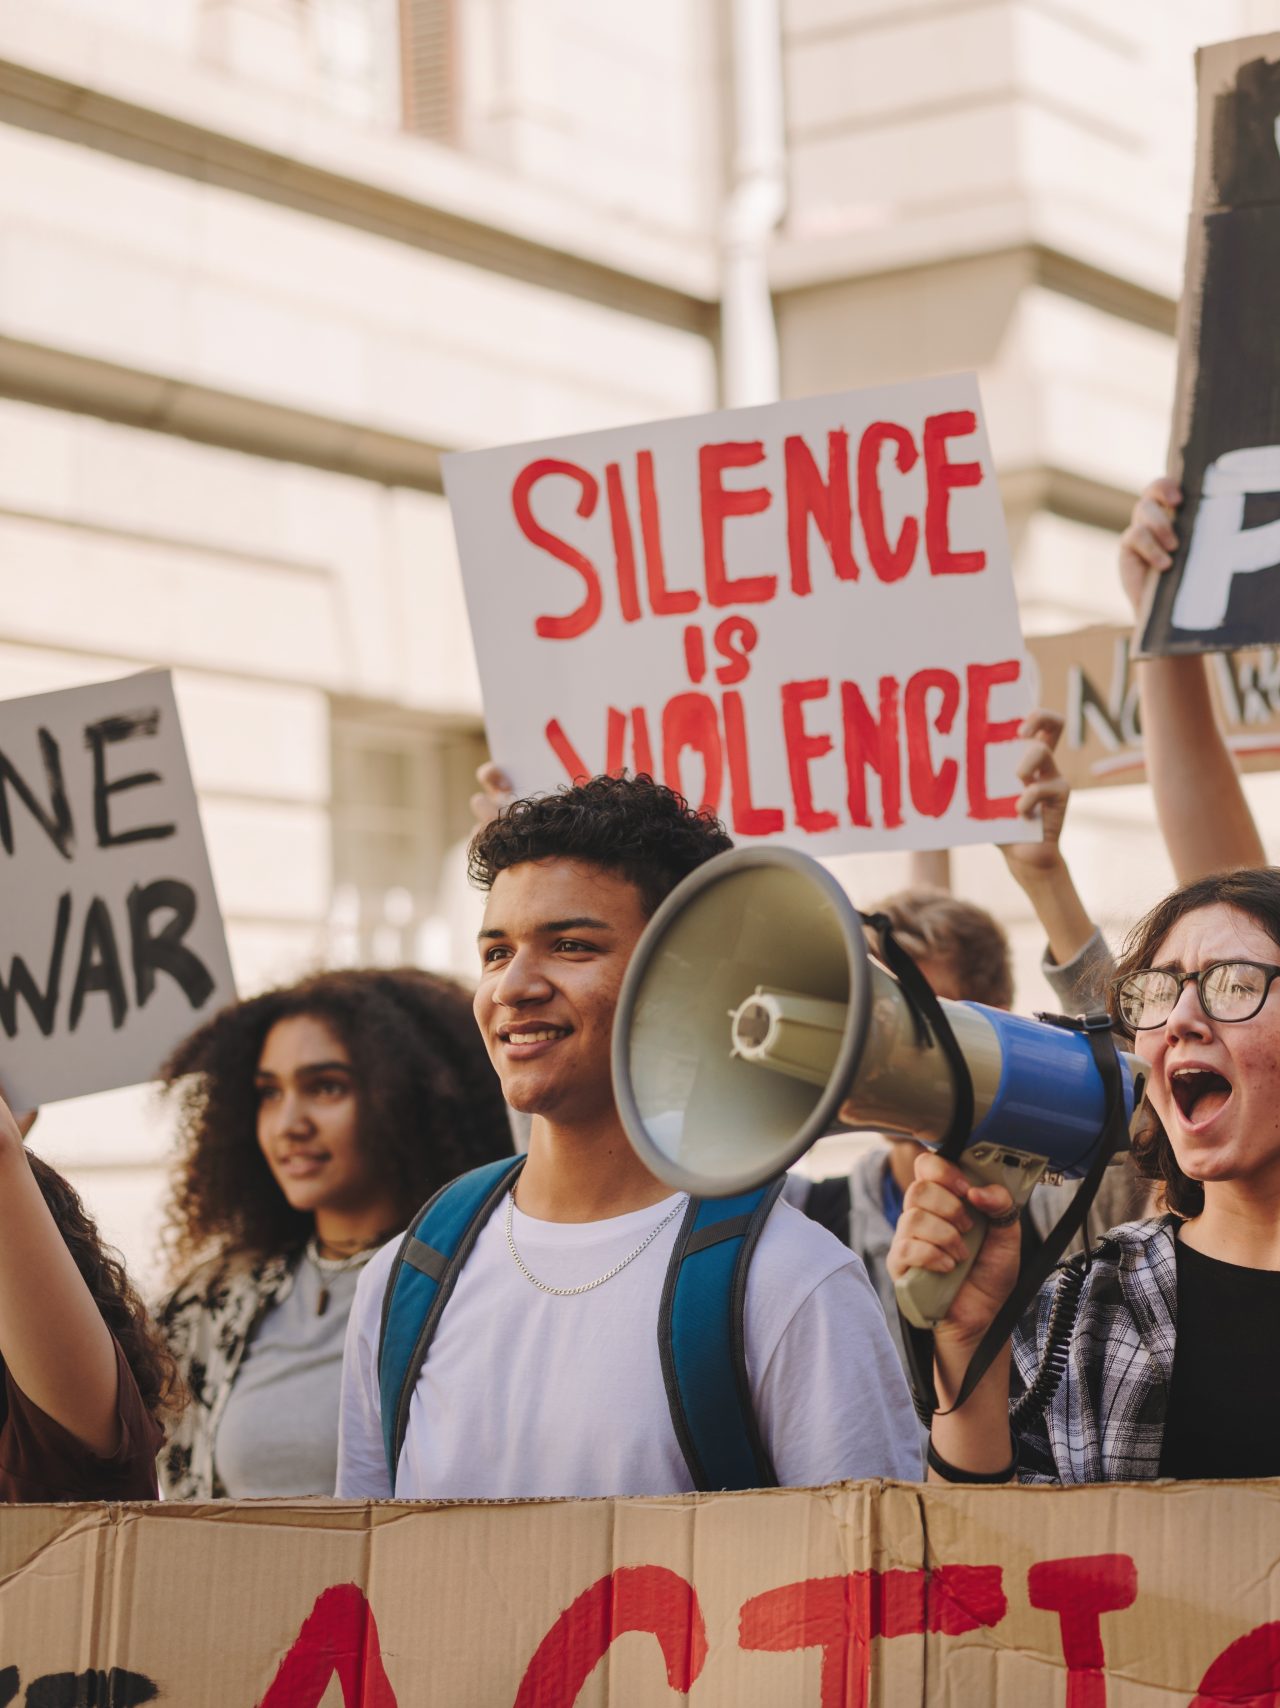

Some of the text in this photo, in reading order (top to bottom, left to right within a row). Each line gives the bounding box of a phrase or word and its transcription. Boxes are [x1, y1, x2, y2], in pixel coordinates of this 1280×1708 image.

[511, 409, 987, 641] SILENCE
[684, 614, 759, 685] IS
[545, 659, 1023, 837] VIOLENCE
[0, 877, 216, 1039] WAR
